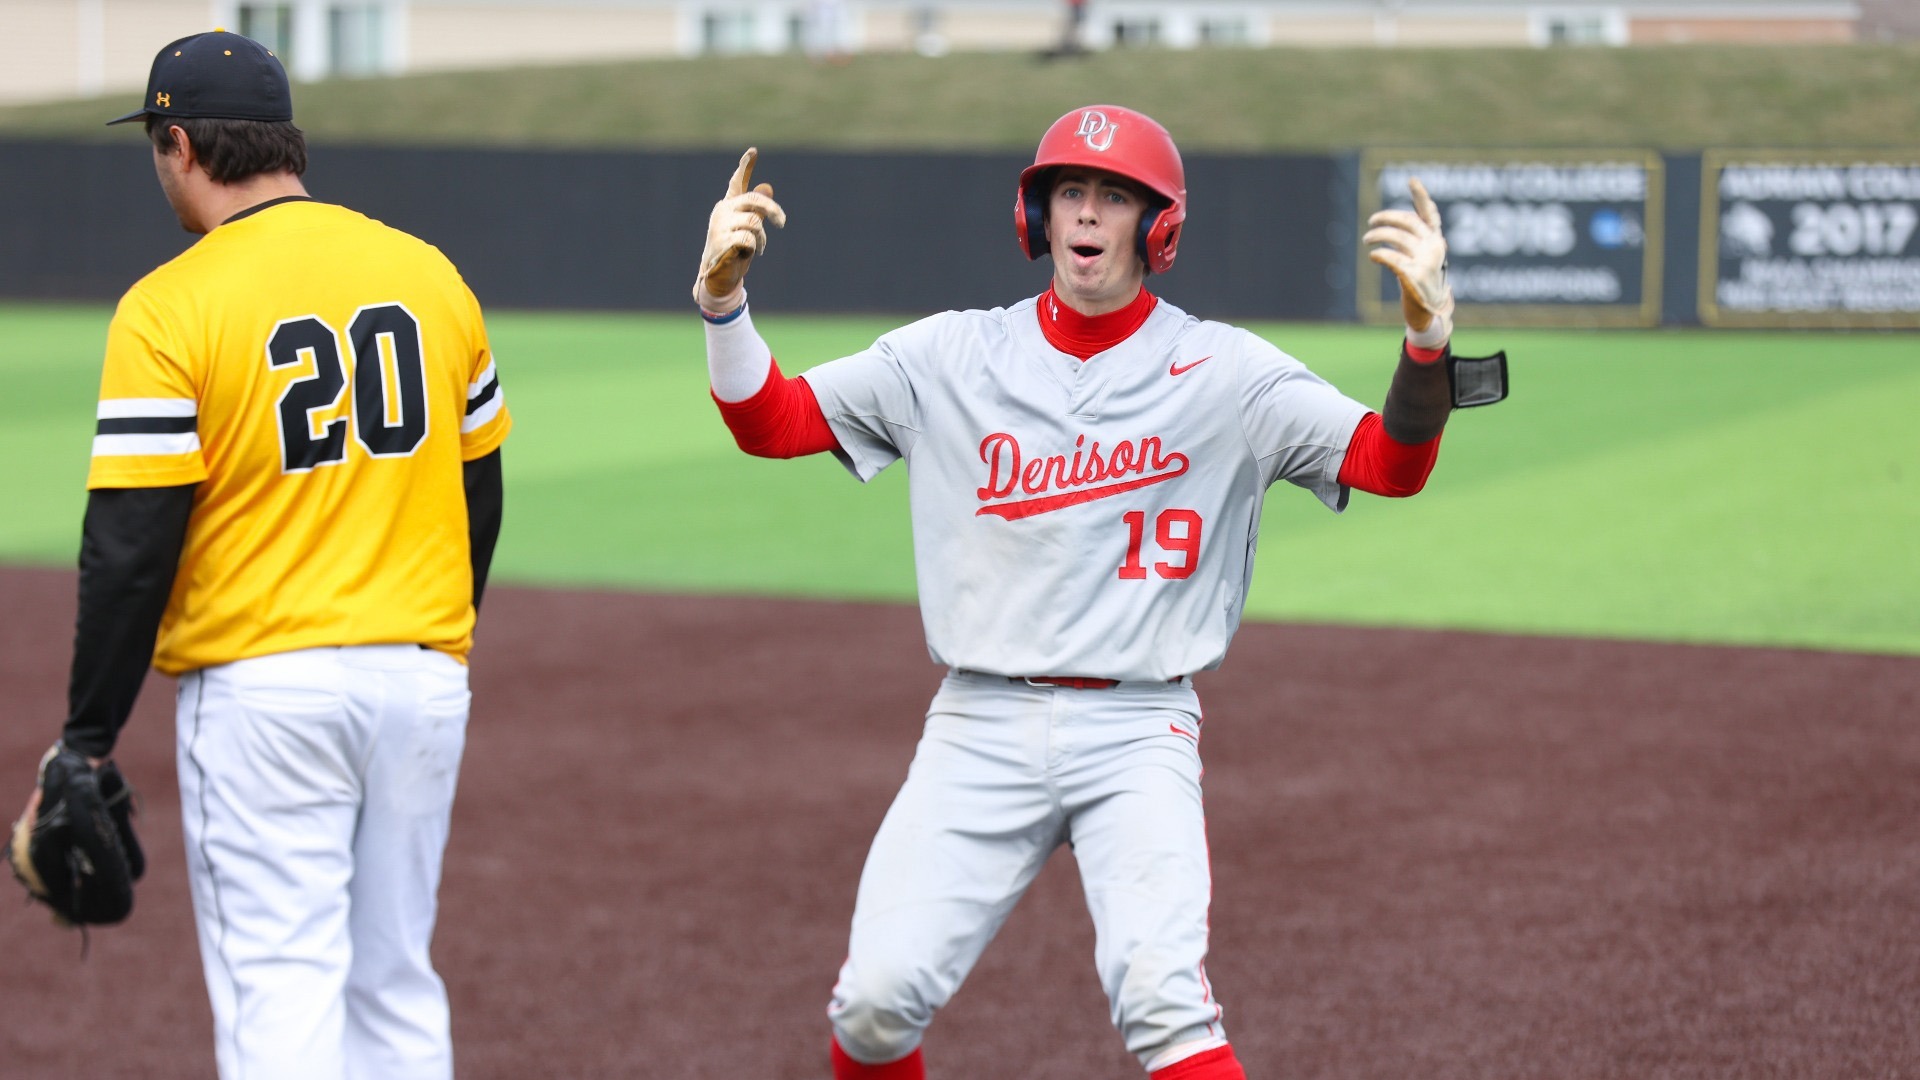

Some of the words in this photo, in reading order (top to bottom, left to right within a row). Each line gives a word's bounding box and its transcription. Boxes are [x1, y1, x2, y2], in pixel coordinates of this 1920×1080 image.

[1075, 110, 1118, 152] DU
[1789, 203, 1917, 255] 2017
[264, 302, 430, 476] 20
[976, 432, 1183, 502] Denison
[1118, 508, 1203, 580] 19
